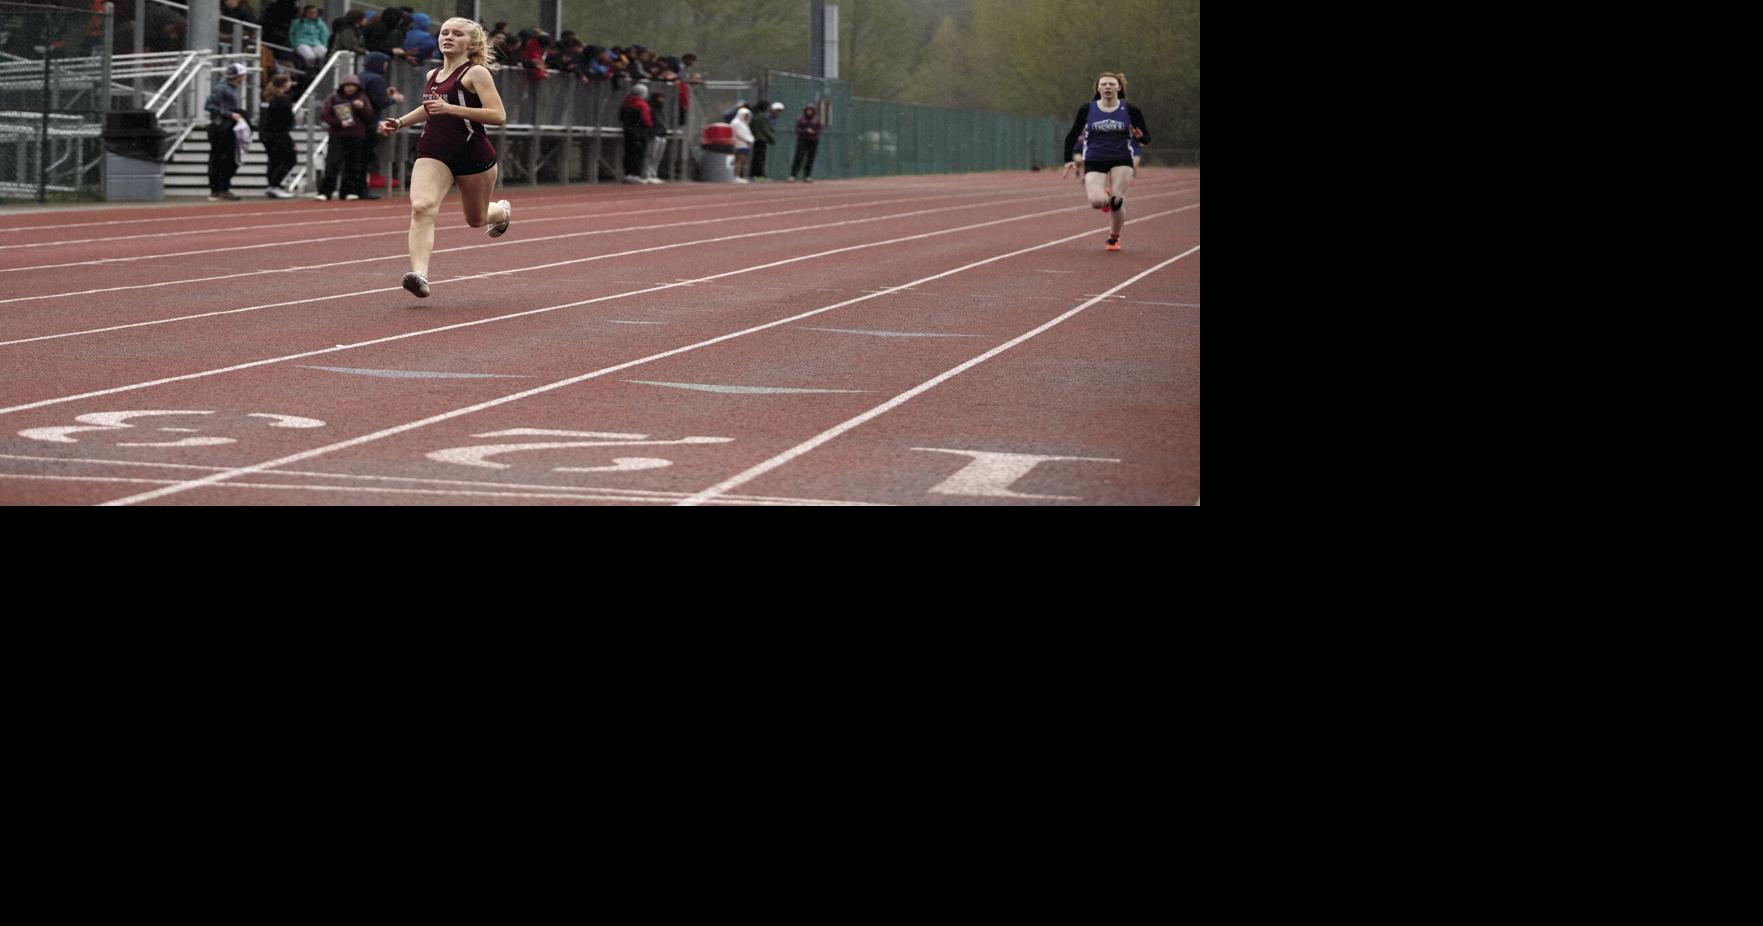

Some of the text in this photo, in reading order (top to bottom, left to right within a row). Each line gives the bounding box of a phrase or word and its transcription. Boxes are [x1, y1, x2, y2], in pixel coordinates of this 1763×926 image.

[17, 410, 326, 447] 3
[424, 427, 736, 472] 2
[910, 446, 1120, 501] 1
